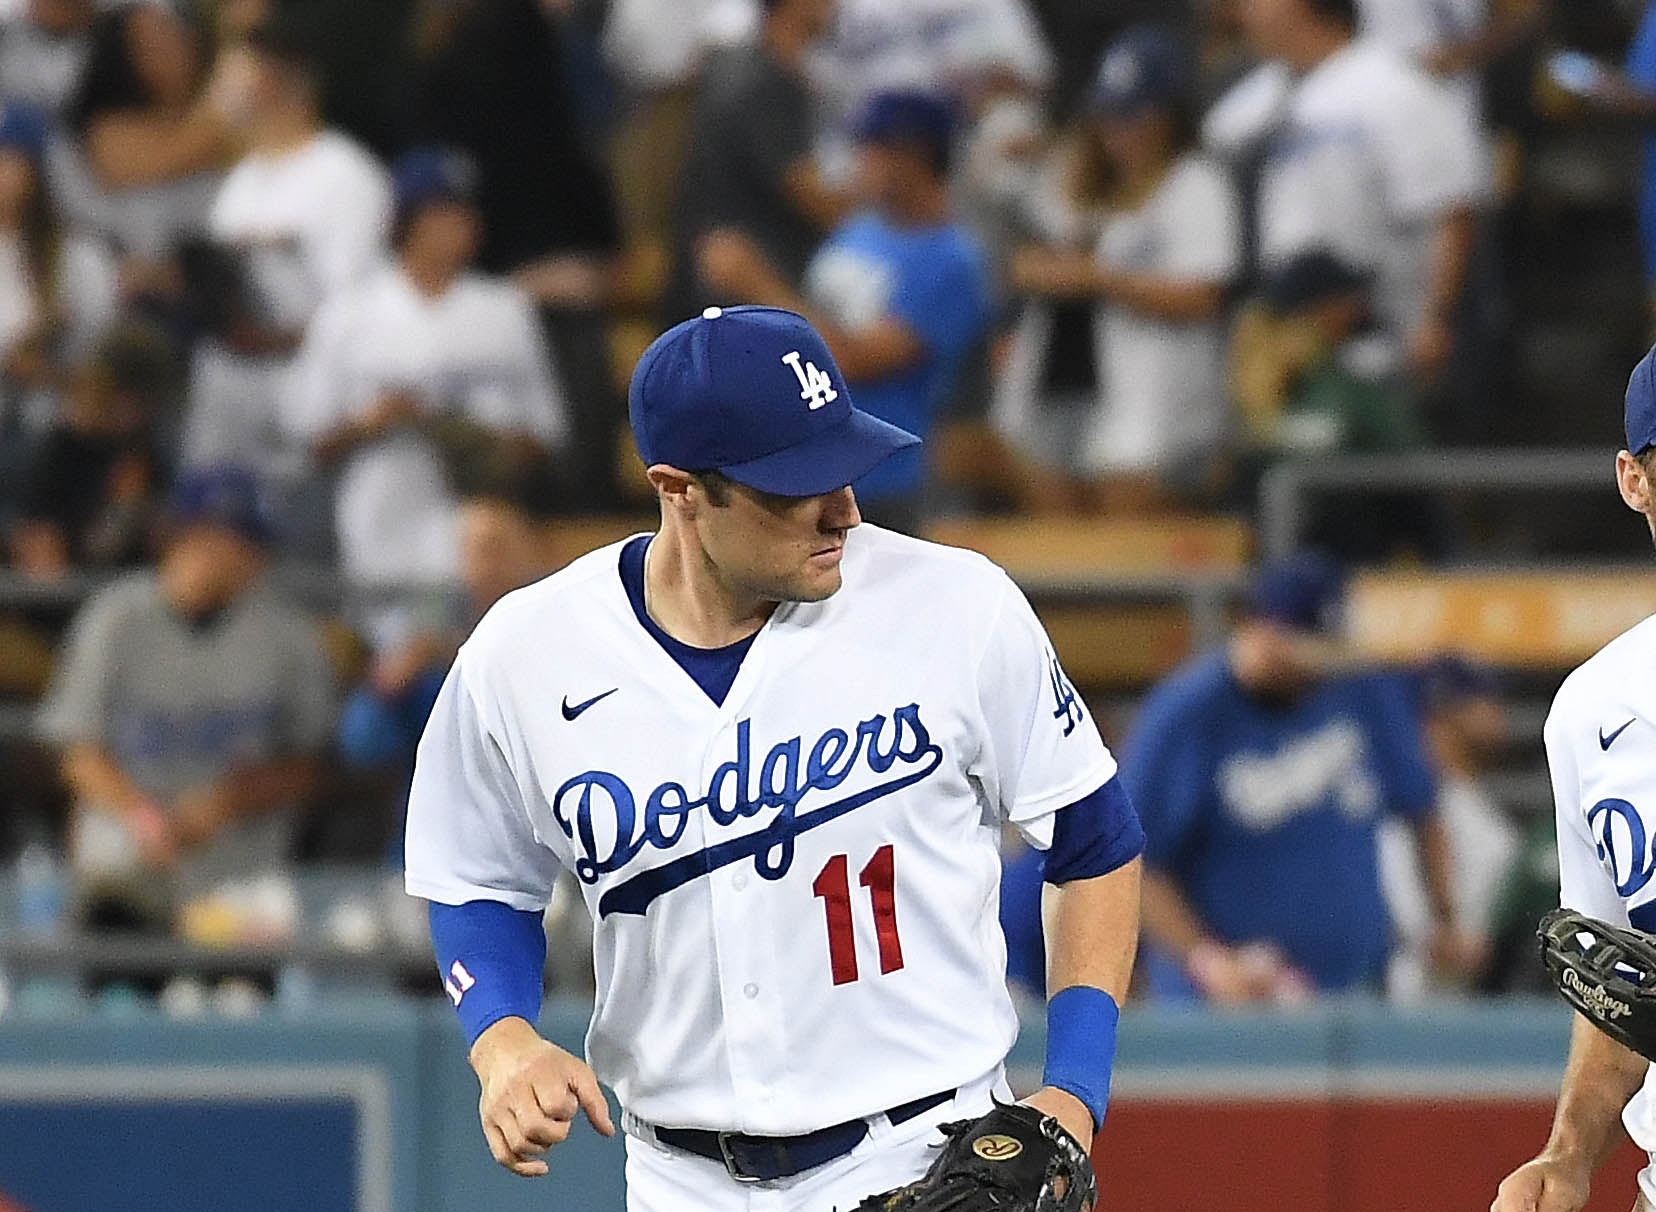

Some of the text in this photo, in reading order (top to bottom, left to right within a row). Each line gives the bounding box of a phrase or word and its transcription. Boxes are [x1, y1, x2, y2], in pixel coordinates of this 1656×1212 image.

[780, 350, 839, 411] LA
[552, 702, 936, 882] Dodgers
[811, 843, 906, 988] 11
